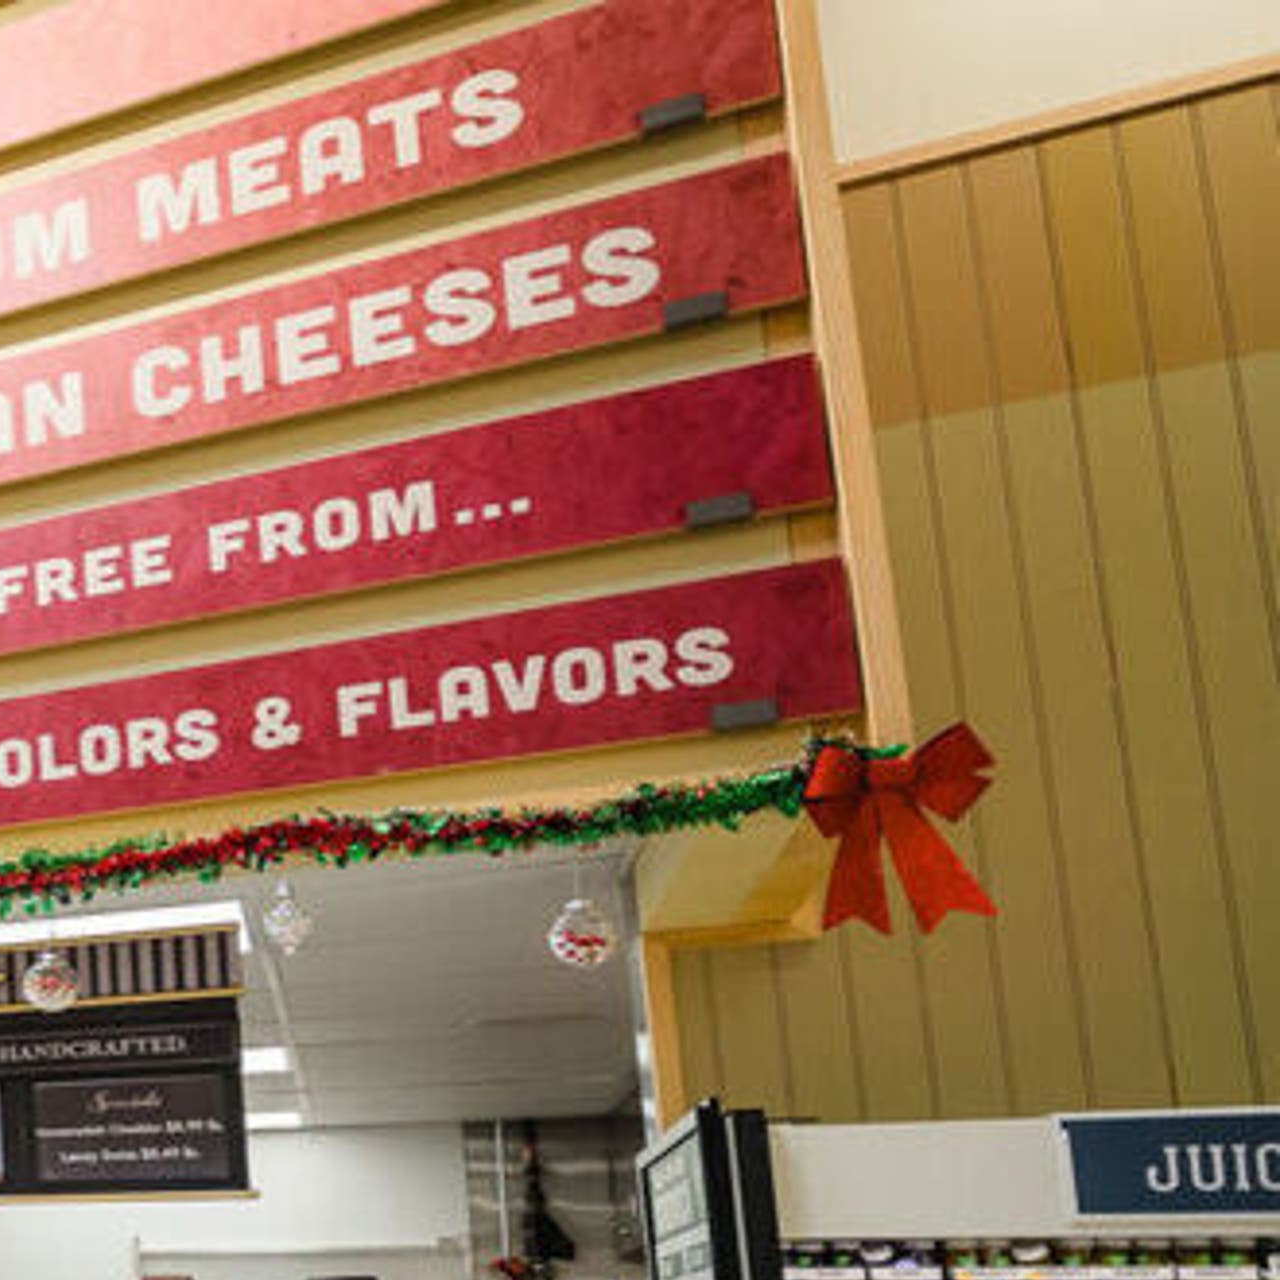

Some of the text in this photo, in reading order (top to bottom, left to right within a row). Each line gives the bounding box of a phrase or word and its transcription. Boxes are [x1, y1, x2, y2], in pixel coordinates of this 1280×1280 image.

[135, 68, 525, 243] MEATS
[132, 225, 661, 418] CHEESES
[251, 697, 303, 750] &
[336, 627, 735, 738] FLAVORS
